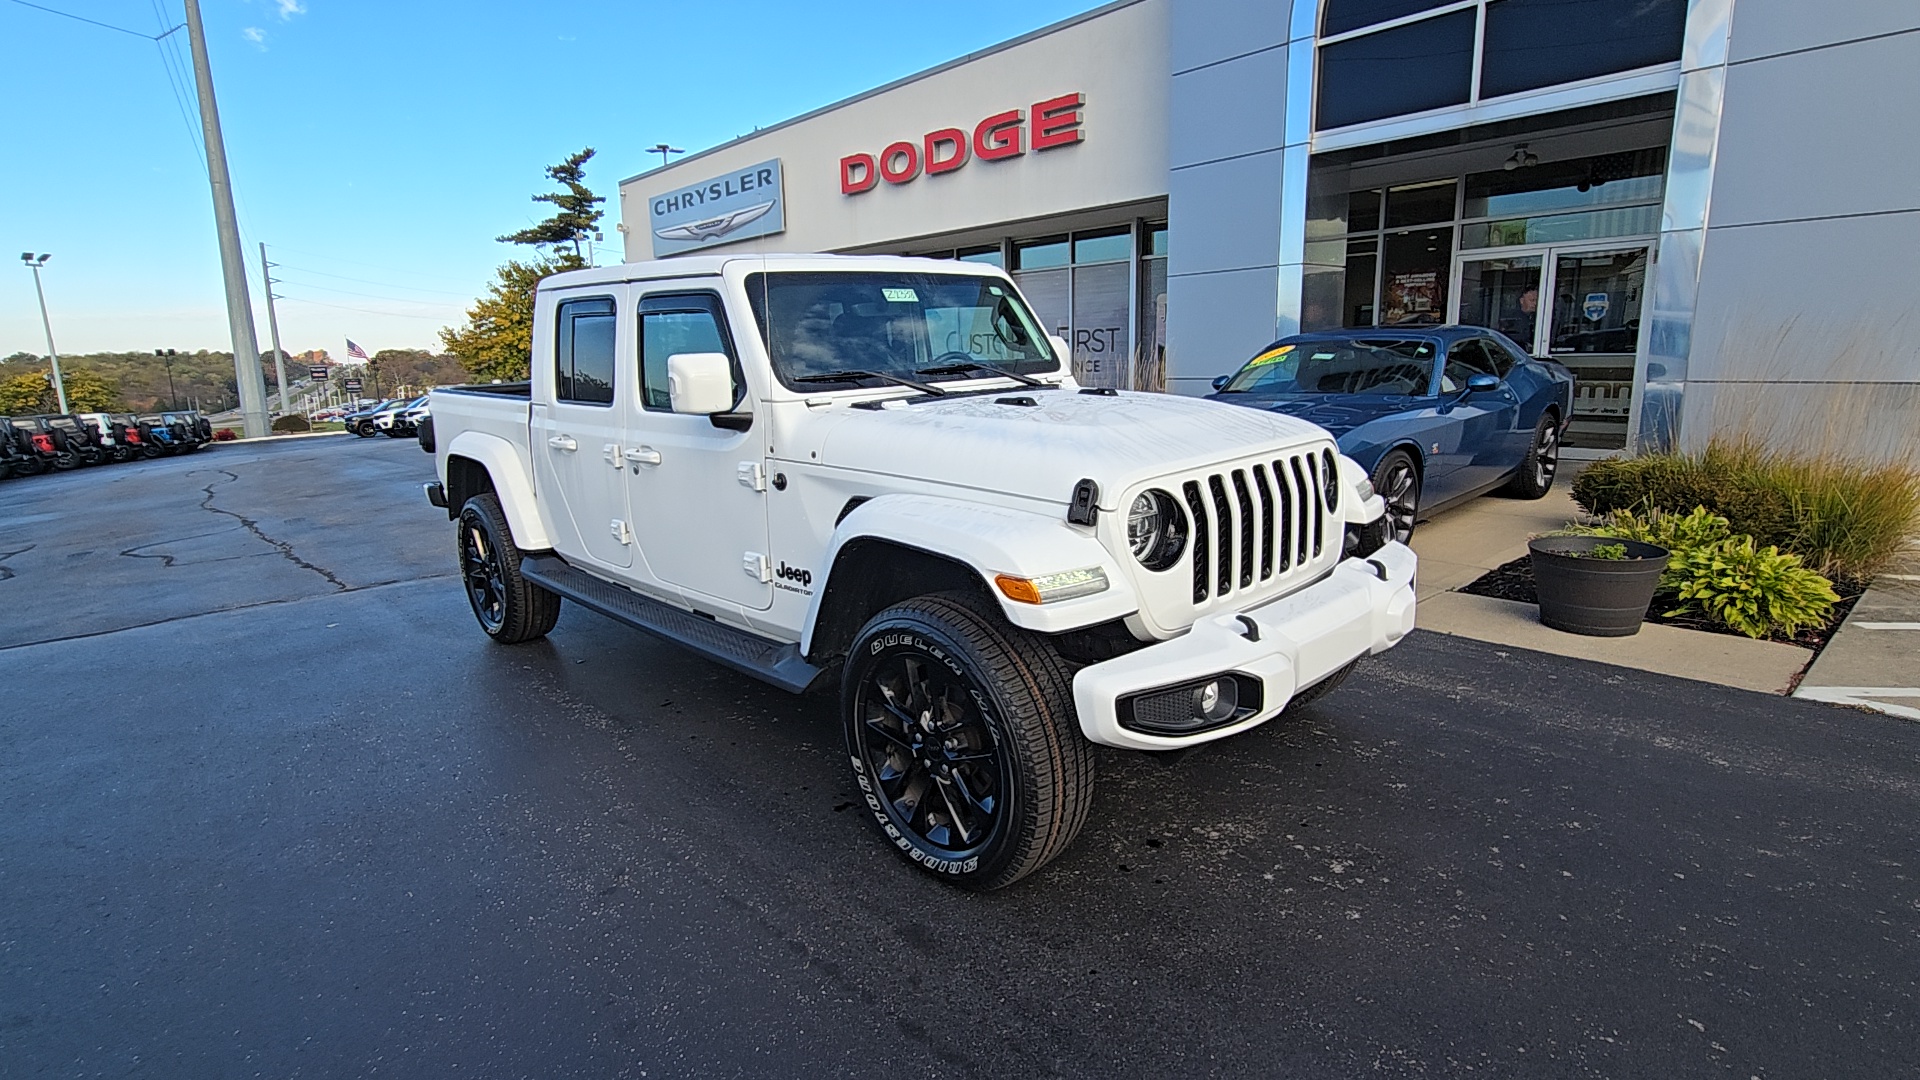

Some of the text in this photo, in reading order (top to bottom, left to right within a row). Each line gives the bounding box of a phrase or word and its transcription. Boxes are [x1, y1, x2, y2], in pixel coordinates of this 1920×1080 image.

[841, 92, 1085, 195] DODGE
[654, 168, 773, 216] CHRYSLER
[776, 561, 811, 587] Jeep
[870, 634, 963, 676] DUELER
[851, 756, 979, 874] BRIDGESTONE
